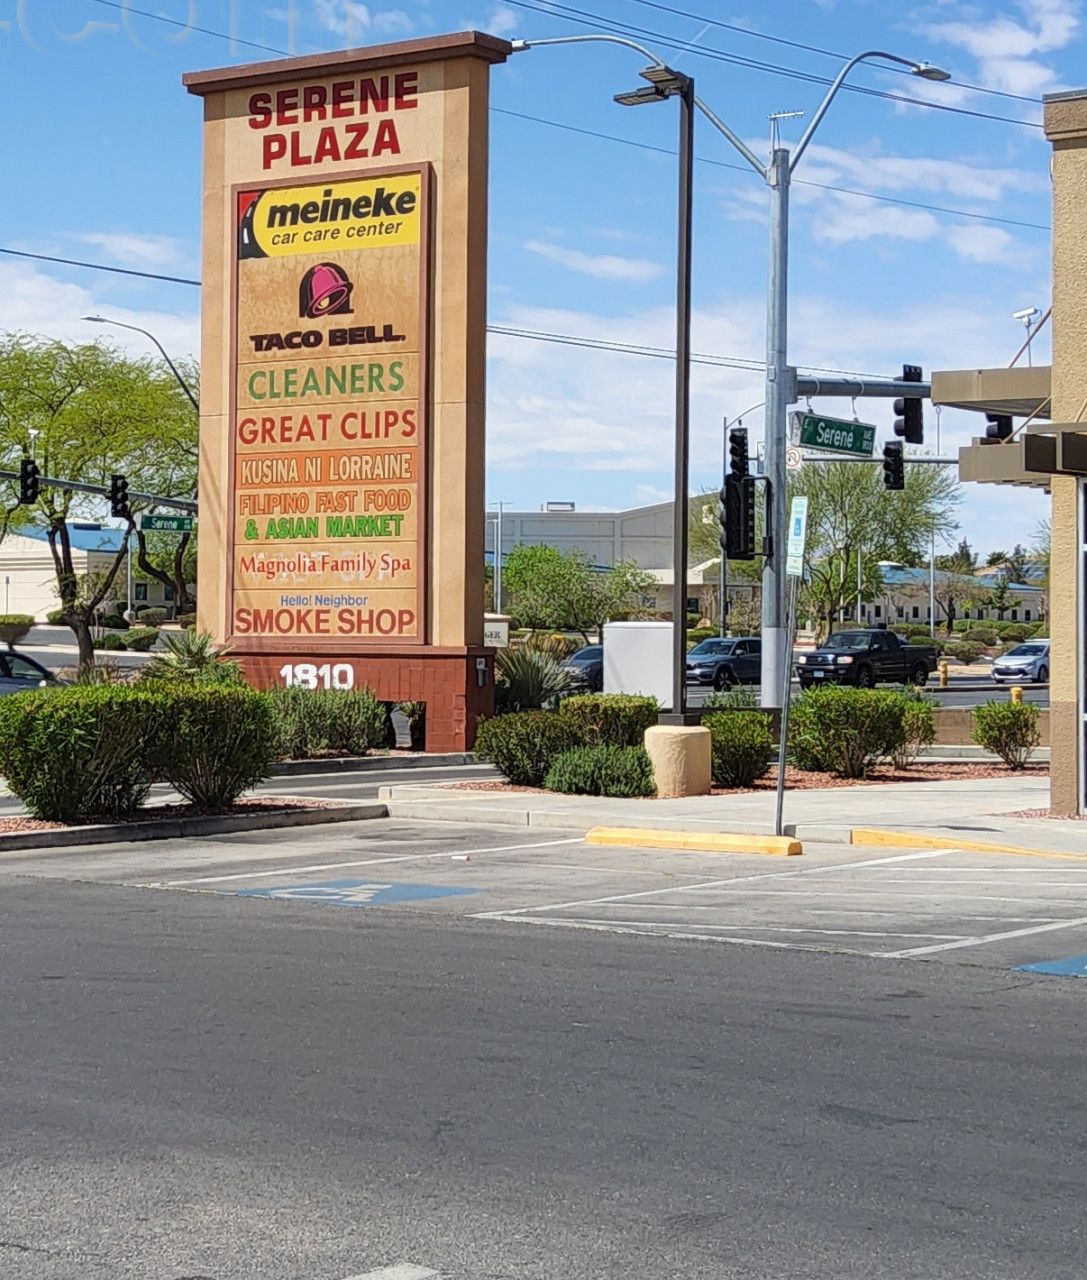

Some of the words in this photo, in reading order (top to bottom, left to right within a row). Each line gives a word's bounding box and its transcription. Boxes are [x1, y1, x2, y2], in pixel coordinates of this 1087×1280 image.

[248, 71, 419, 130] SERENE
[262, 118, 401, 170] PLAZA
[266, 187, 417, 228] meineke
[271, 231, 299, 246] car
[303, 228, 341, 242] care
[346, 220, 403, 237] center
[250, 330, 323, 352] TACO
[328, 324, 406, 346] BELL
[248, 361, 405, 400] CLEANERS
[238, 414, 332, 445] GREAT
[340, 409, 416, 440] CLIPS
[816, 421, 854, 448] Serene
[240, 457, 299, 486] KUSINA
[304, 456, 322, 483] NI
[328, 453, 412, 482] LORRAINE
[239, 492, 310, 516] FILIPINO
[315, 490, 358, 513] FAST
[363, 488, 412, 512] FOOD
[151, 518, 177, 529] Serene
[244, 519, 259, 540] &
[265, 516, 319, 539] ASIAN
[326, 514, 404, 538] MARKET
[239, 554, 316, 580] Magnolia
[321, 551, 377, 578] Family
[380, 553, 412, 578] Spa
[280, 595, 312, 607] Hello!
[314, 594, 369, 608] Neighbor
[235, 607, 331, 634] SMOKE
[337, 608, 415, 635] SHOP
[279, 663, 354, 691] 1810
